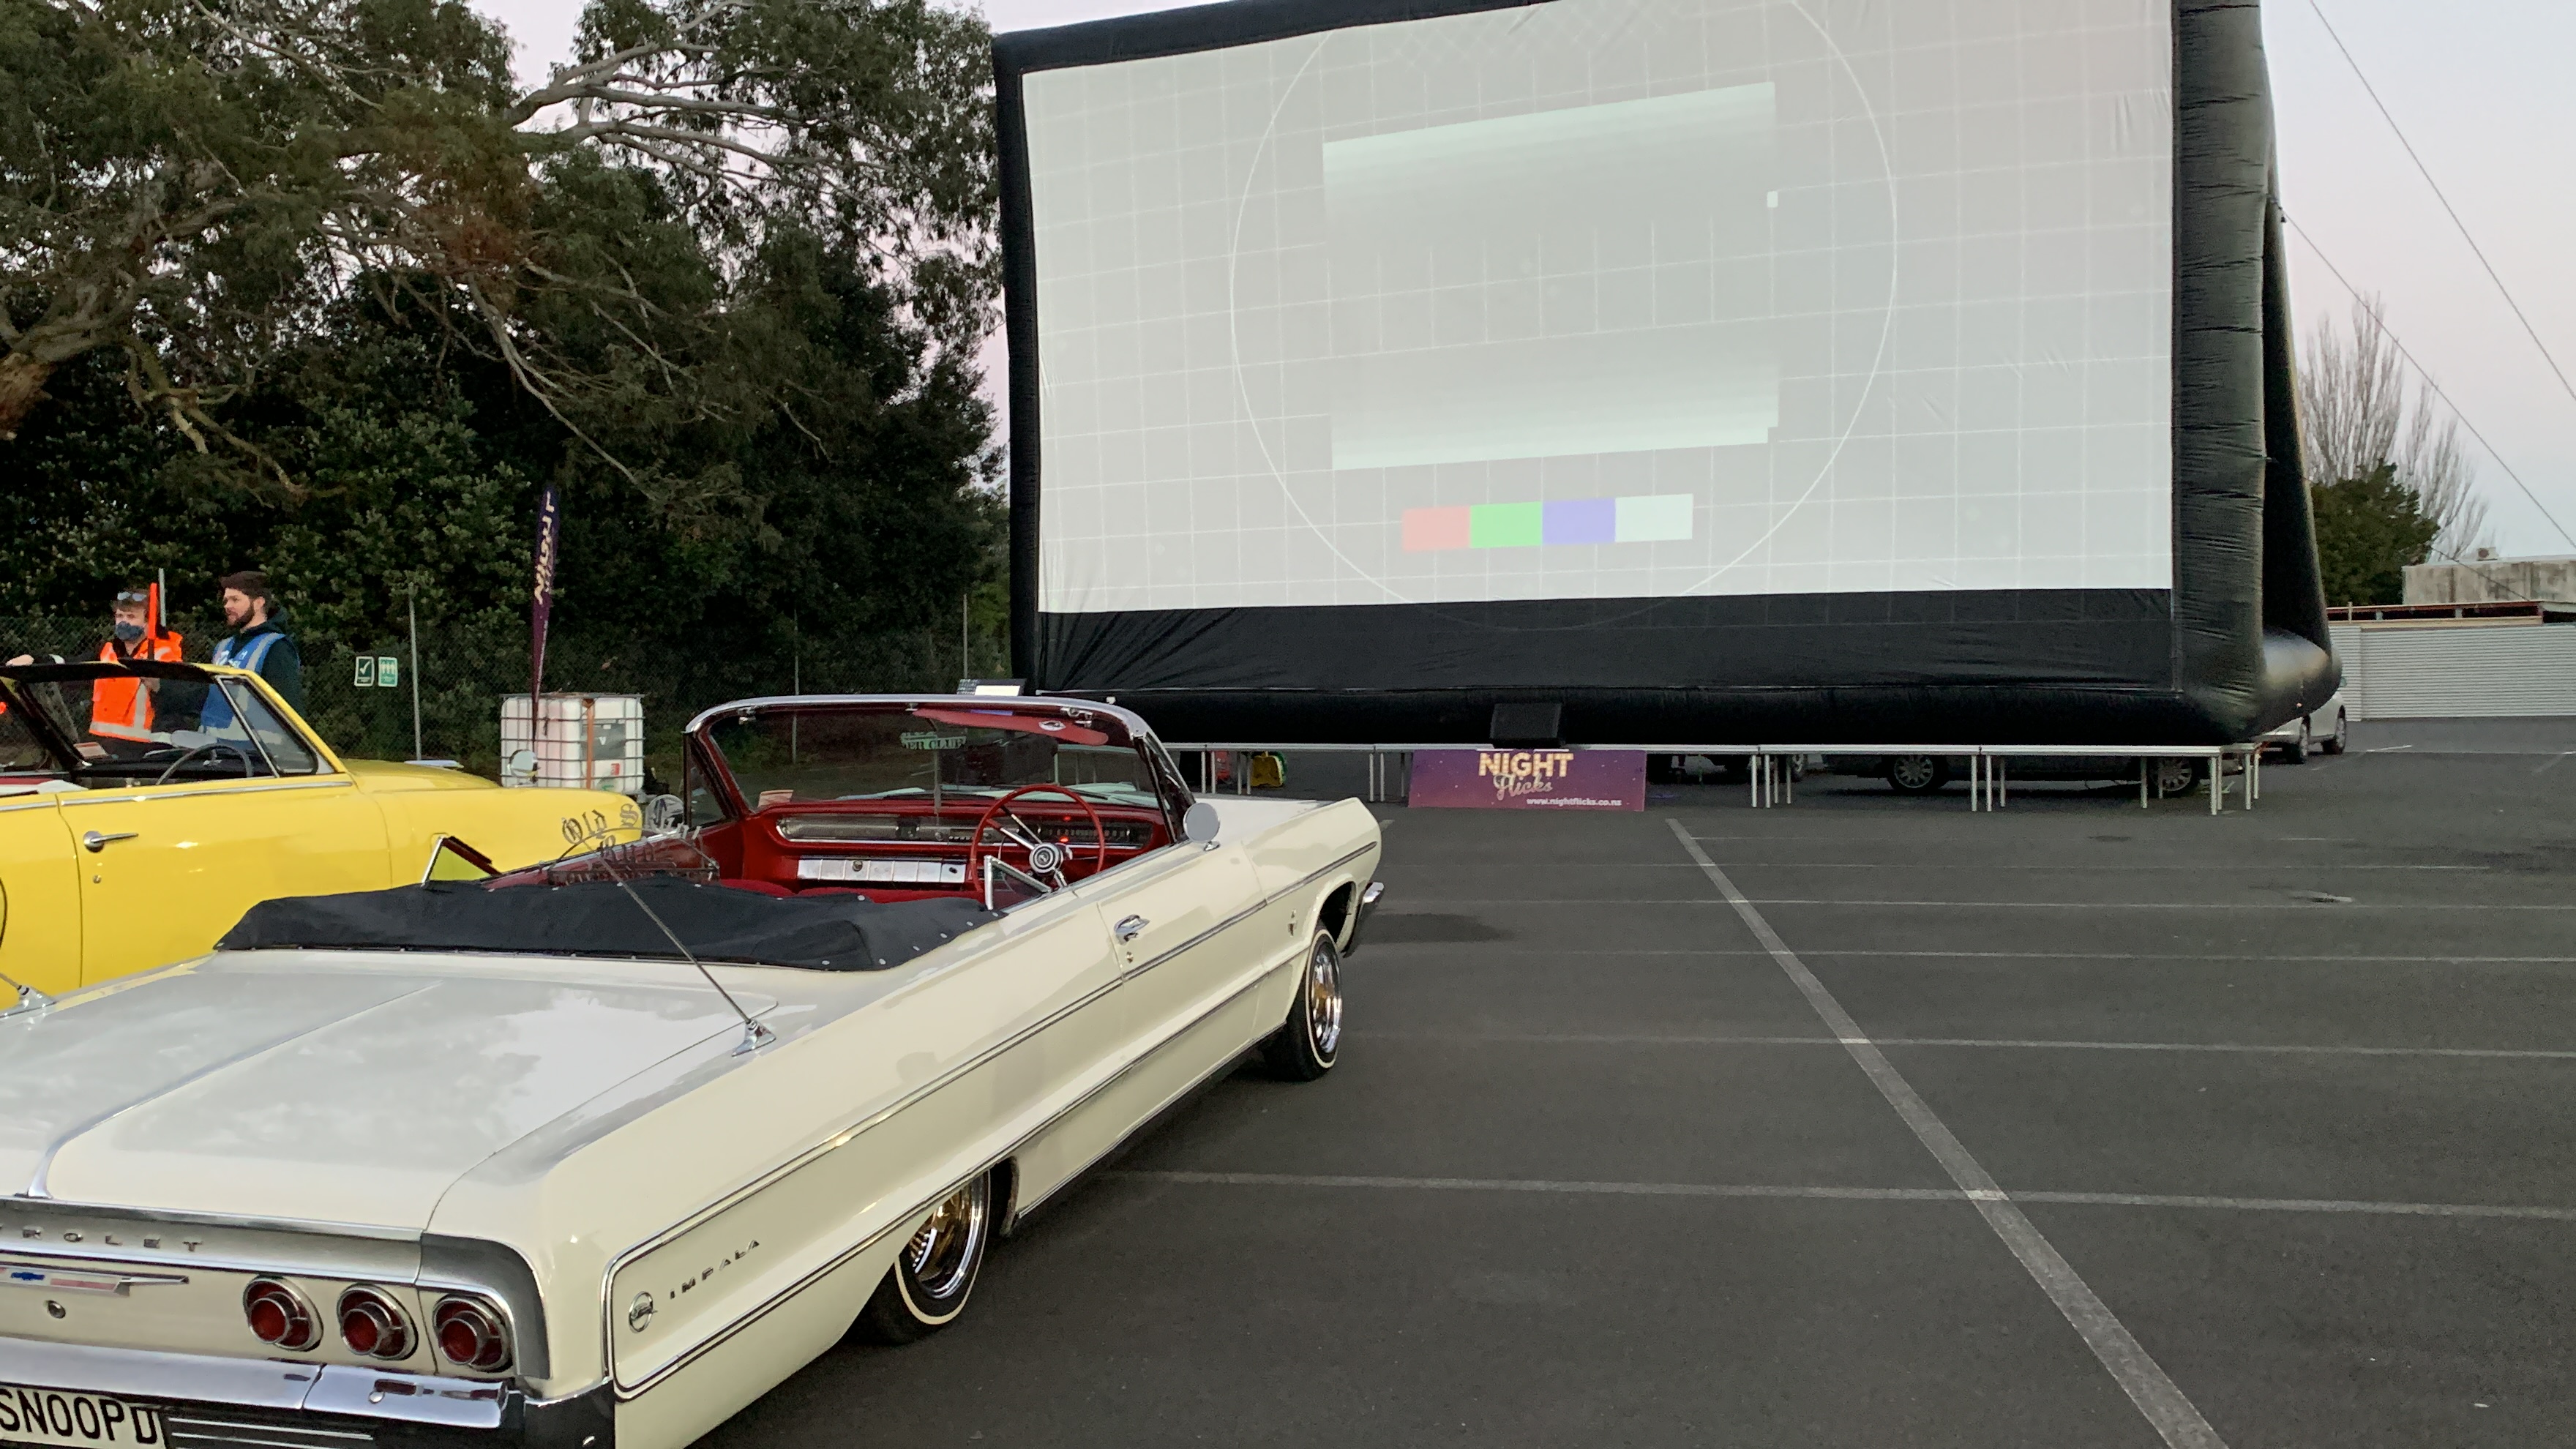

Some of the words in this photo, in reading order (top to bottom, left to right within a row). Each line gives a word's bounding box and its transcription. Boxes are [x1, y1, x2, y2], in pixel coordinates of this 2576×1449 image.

[1479, 752, 1574, 777] NIGHT
[1494, 773, 1553, 801] Flicks
[0, 1224, 203, 1252] ROLET
[670, 1240, 760, 1300] IMPALA
